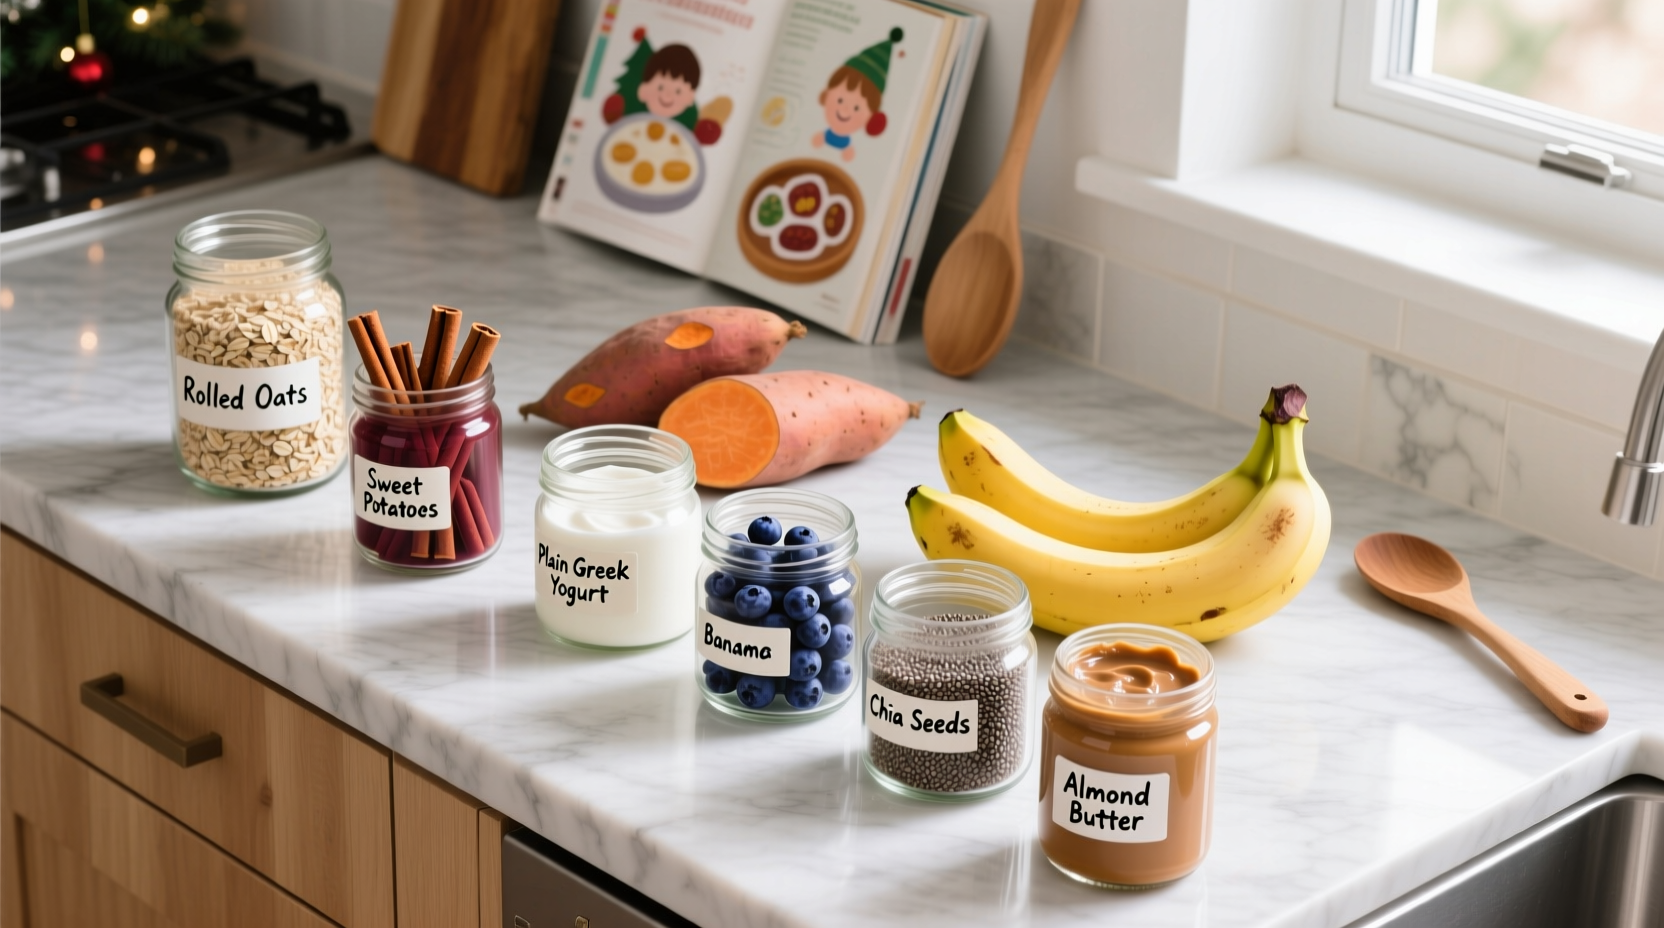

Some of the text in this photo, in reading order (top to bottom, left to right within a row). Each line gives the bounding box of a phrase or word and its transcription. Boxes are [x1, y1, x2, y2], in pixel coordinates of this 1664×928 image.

[183, 375, 308, 410] Rolled Oats
[366, 467, 424, 496] Sweet
[363, 491, 439, 519] Potatoes
[538, 542, 630, 581] Plain Greek
[550, 573, 609, 607] Yogurt
[870, 693, 970, 735] Chia Seeds
[1063, 771, 1151, 806] Almond
[1069, 800, 1144, 831] Butter
